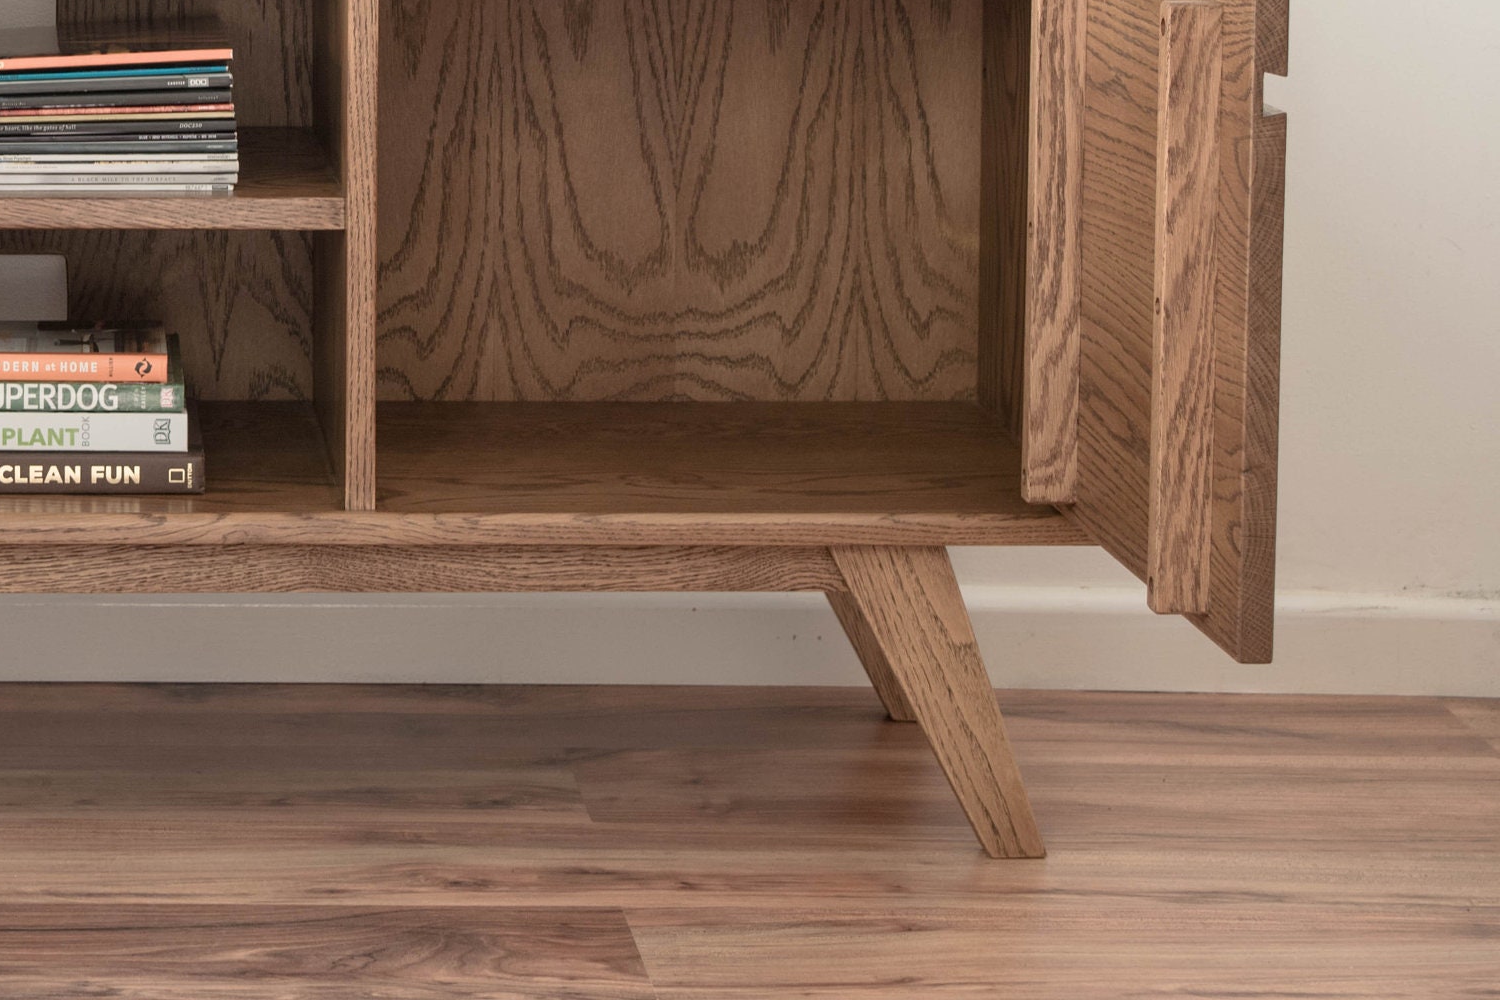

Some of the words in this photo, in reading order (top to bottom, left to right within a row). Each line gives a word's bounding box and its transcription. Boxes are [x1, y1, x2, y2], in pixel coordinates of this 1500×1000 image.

[45, 361, 57, 372] at
[60, 360, 98, 373] HOME
[2, 428, 79, 447] PLANT
[81, 416, 91, 447] BOOK
[154, 418, 170, 444] DK
[90, 465, 141, 484] FUN
